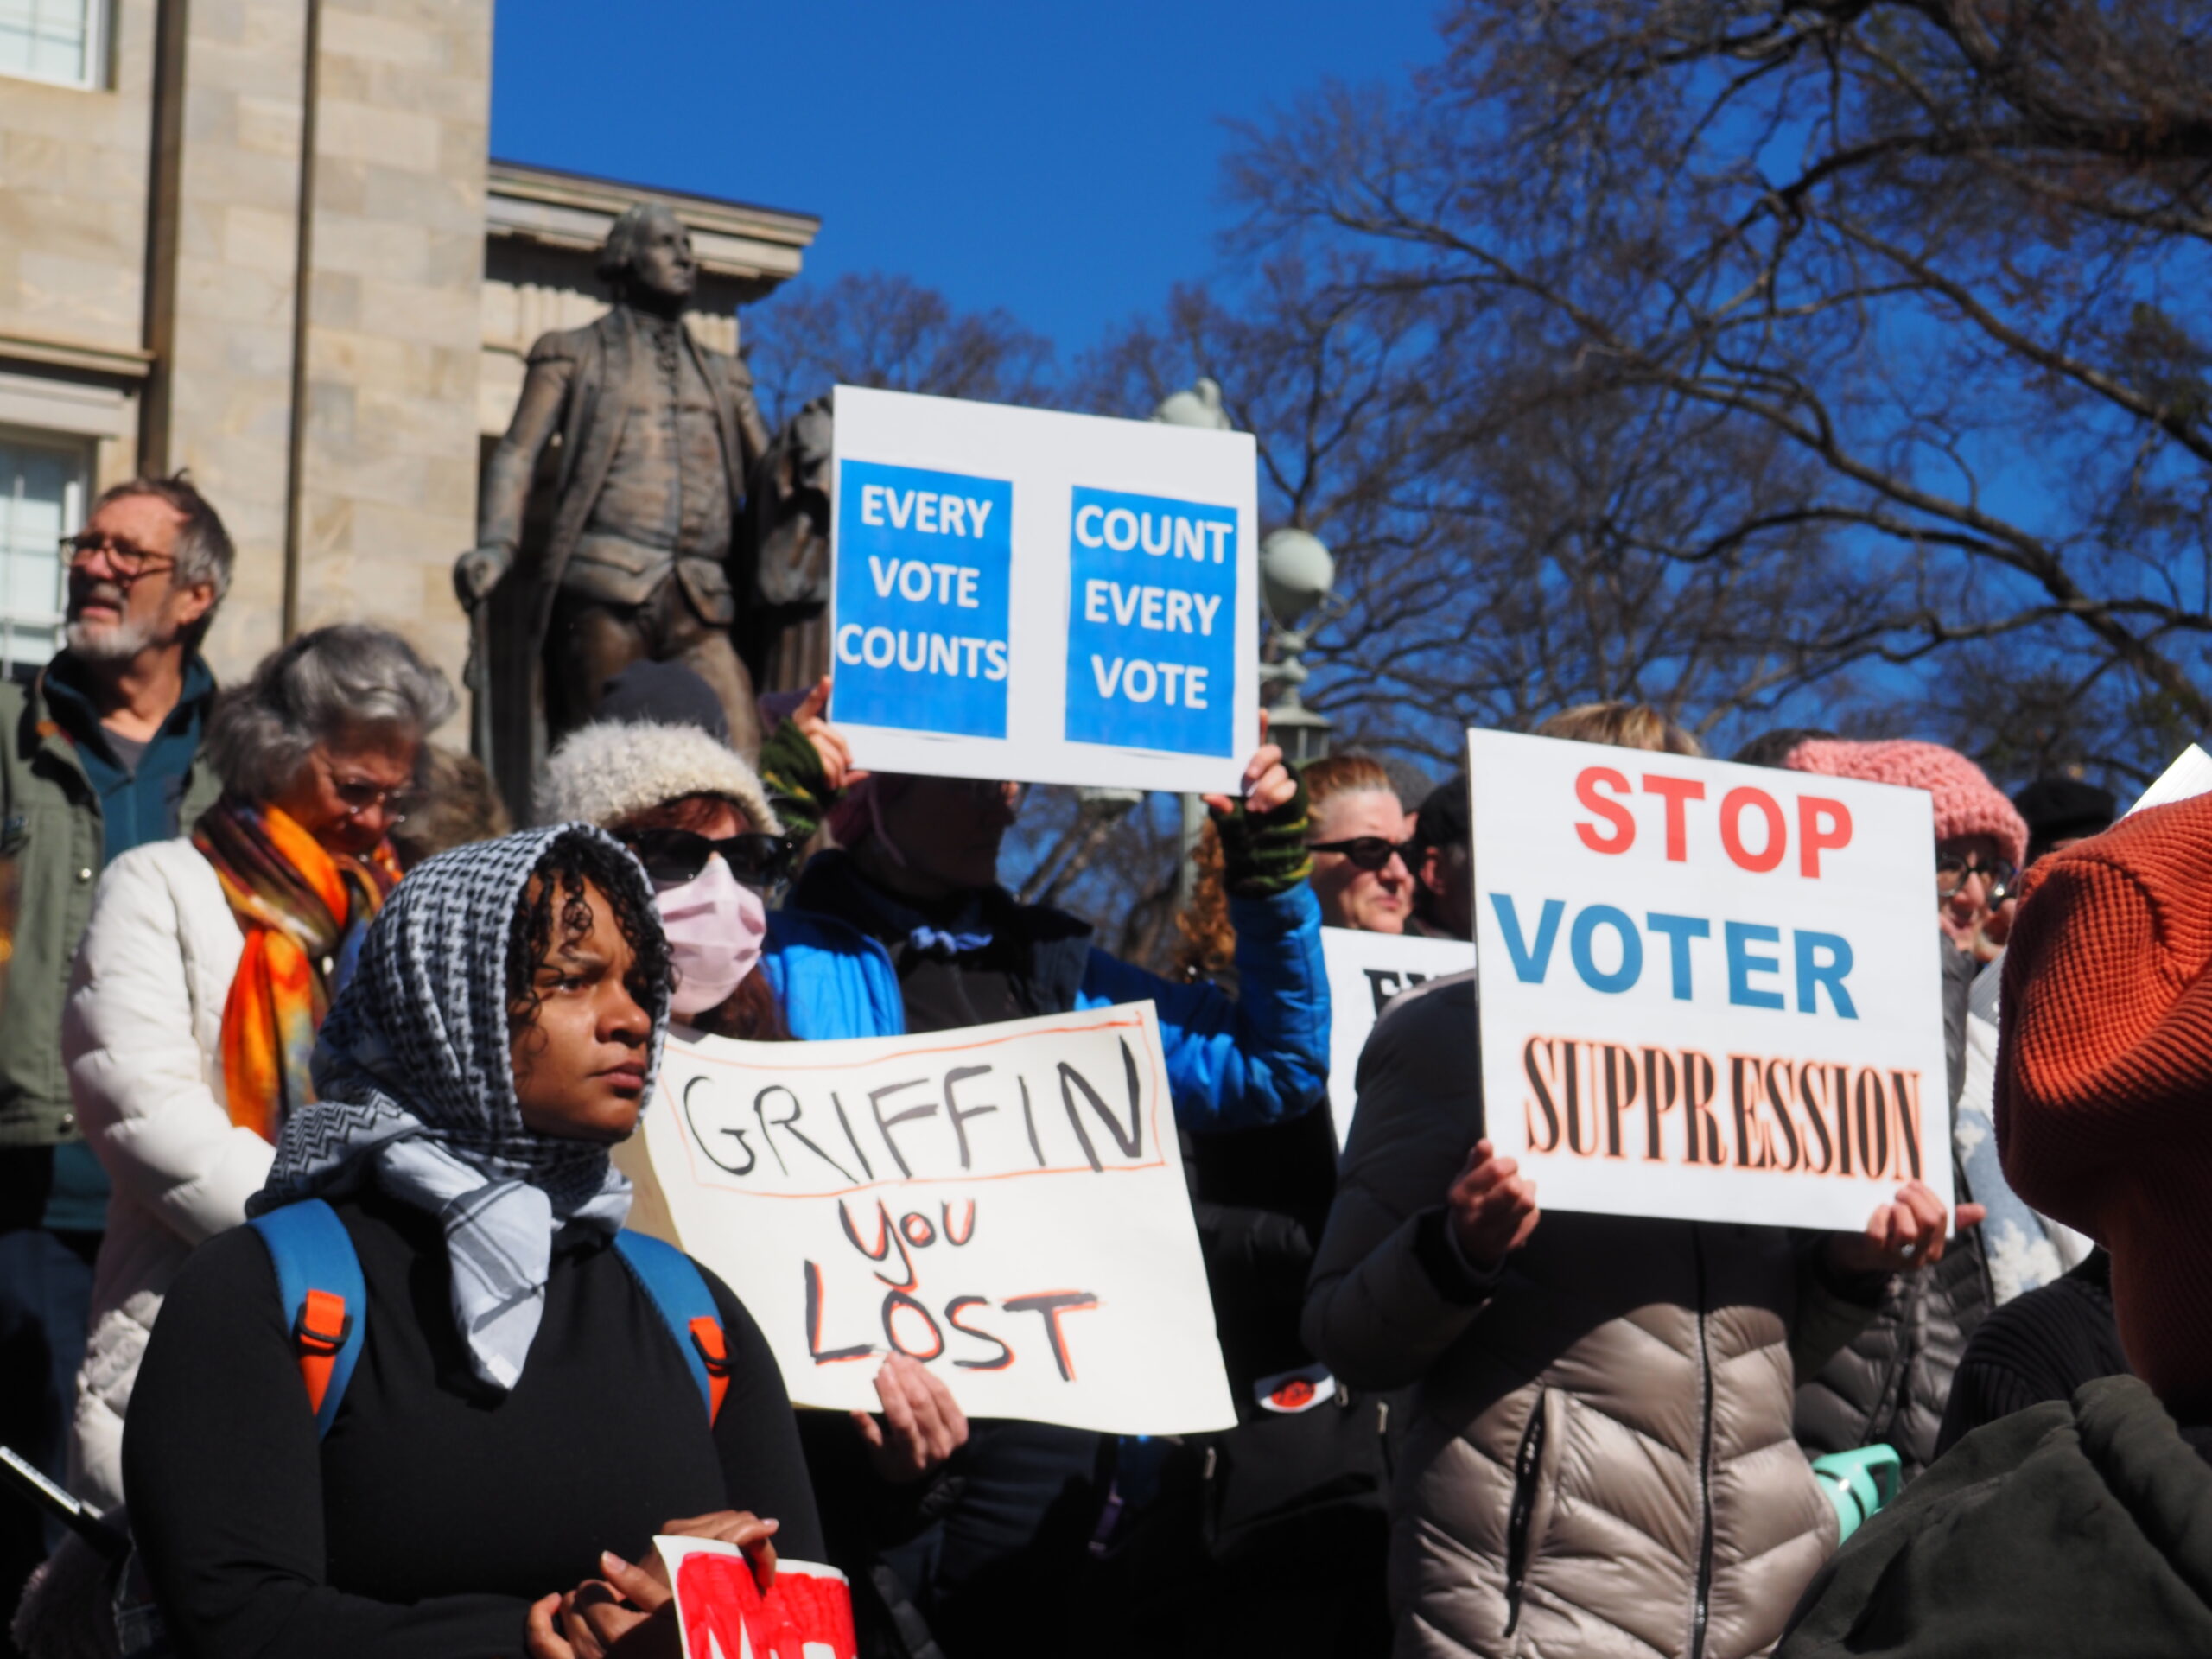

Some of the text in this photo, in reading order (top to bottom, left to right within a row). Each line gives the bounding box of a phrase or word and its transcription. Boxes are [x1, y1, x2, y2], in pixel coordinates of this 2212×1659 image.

[861, 485, 992, 538] EVERY
[1075, 505, 1233, 564] COUNT
[868, 556, 980, 608] VOTE
[1085, 579, 1221, 636] EVERY
[836, 624, 1007, 681] COUNTS
[1091, 654, 1209, 709] VOTE
[1574, 766, 1853, 879] STOP
[1489, 893, 1859, 1020] VOTER
[683, 1036, 1142, 1185] GRIFFIN
[1523, 1034, 1923, 1182] SUPPRESSION
[804, 1260, 1101, 1382] LOST
